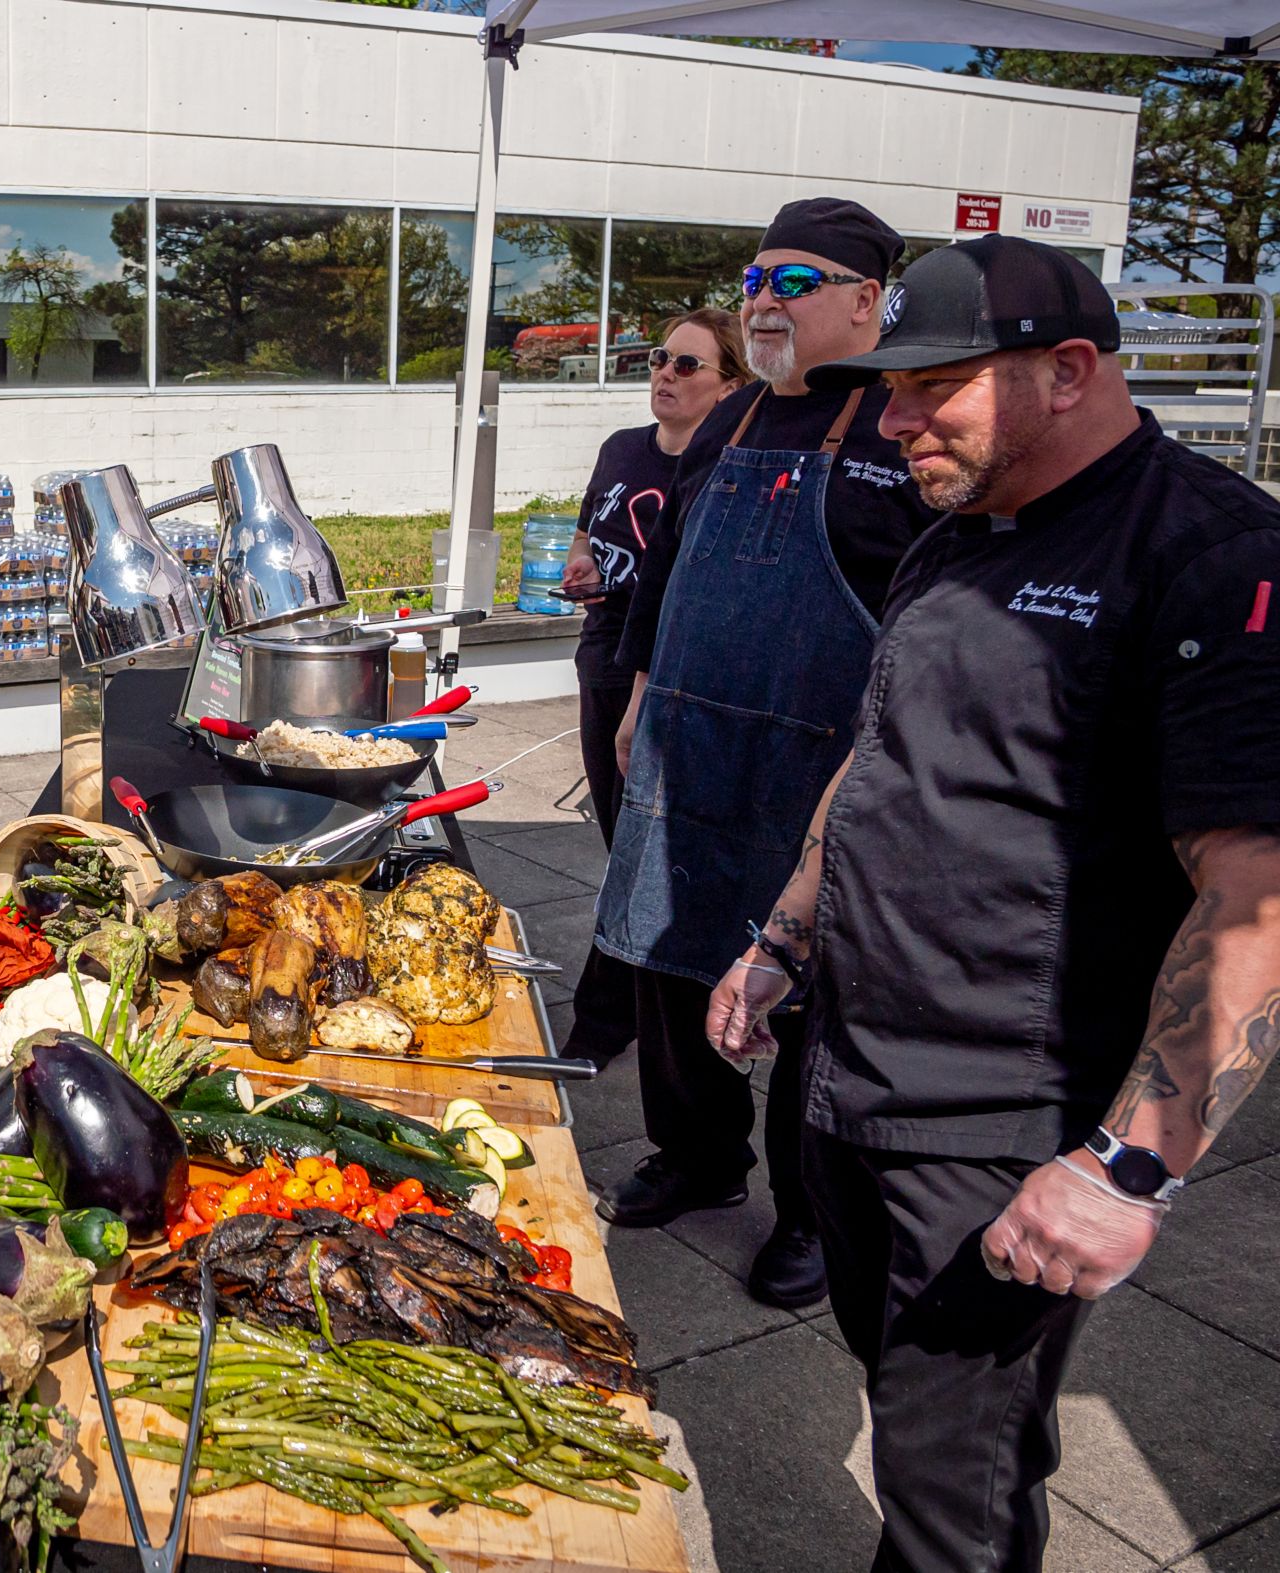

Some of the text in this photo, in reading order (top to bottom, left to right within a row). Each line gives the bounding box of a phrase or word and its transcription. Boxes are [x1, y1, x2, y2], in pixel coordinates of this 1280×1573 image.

[959, 197, 999, 209] Student Center
[969, 208, 988, 218] Annex
[1026, 208, 1051, 228] NO
[843, 458, 910, 484] Campus Executive Chef
[1023, 600, 1067, 617] Executive
[1069, 608, 1098, 628] Chef
